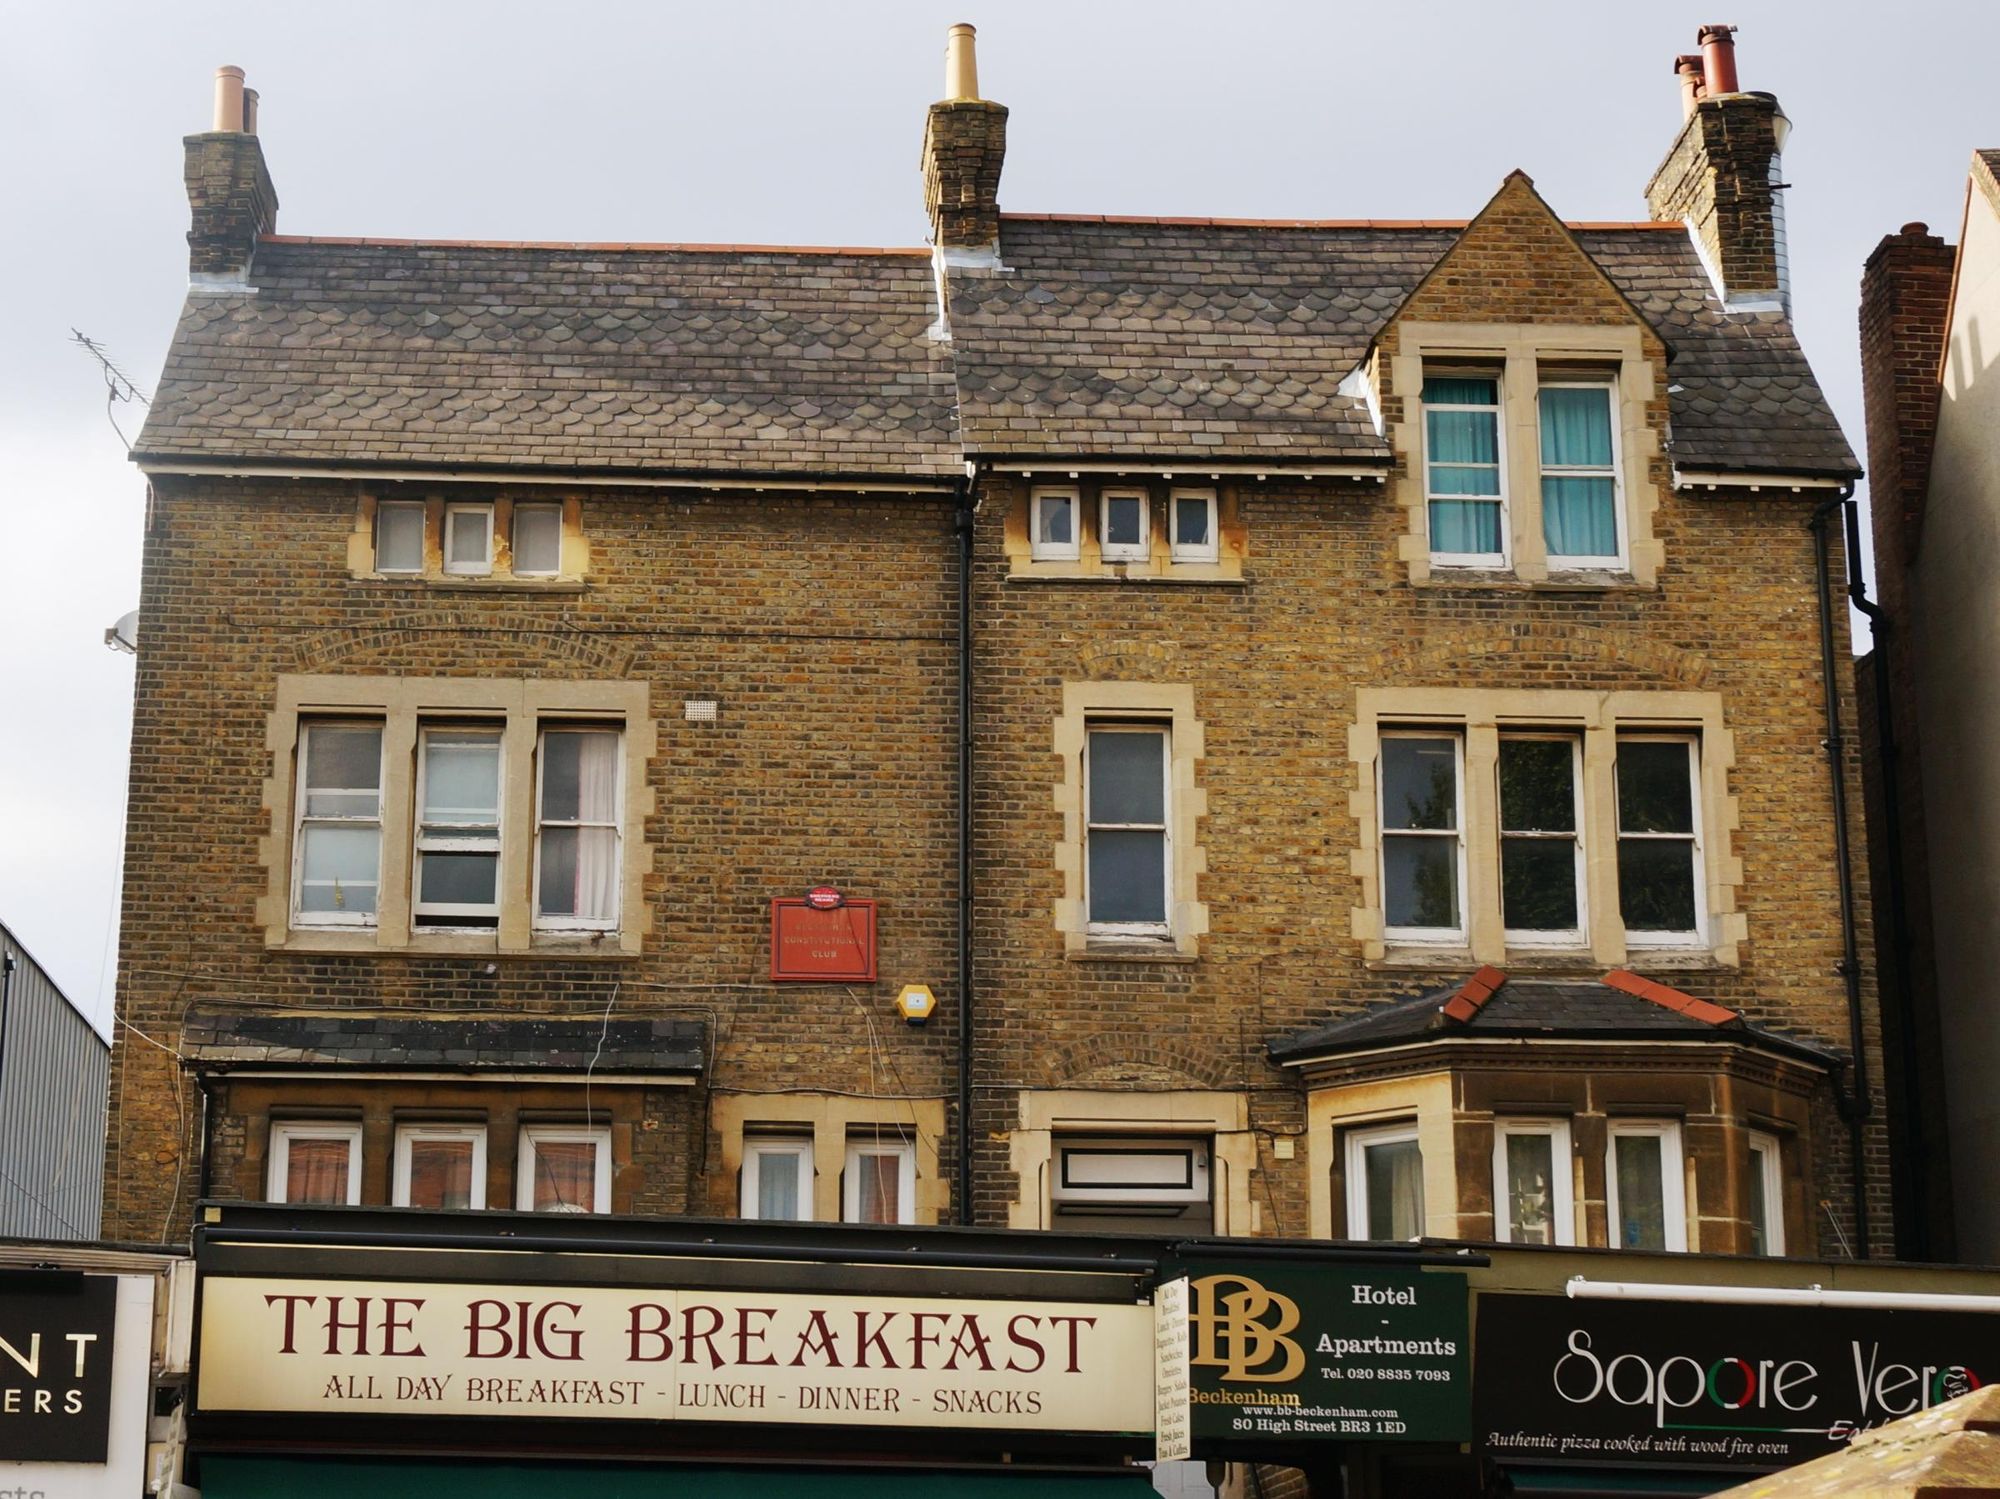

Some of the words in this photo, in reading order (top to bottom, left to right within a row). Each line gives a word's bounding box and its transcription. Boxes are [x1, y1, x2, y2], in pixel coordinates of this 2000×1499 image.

[811, 950, 838, 959] CLUB
[1352, 1285, 1417, 1306] Hotel
[263, 1294, 427, 1358] THE
[463, 1299, 585, 1361] BIG
[624, 1303, 1098, 1375] BREAKFAST
[1315, 1333, 1457, 1359] Apartments
[1321, 1367, 1345, 1379] Tel.
[1347, 1367, 1374, 1380] 020
[1416, 1369, 1451, 1382] 7093
[1553, 1329, 1818, 1429] Sapore
[4, 1388, 83, 1414] ERS
[323, 1374, 383, 1400] ALL
[396, 1374, 453, 1401] DAY
[466, 1377, 645, 1405] BREAKFAST
[679, 1383, 765, 1409] LUNCH
[798, 1386, 900, 1414] DINNER
[932, 1389, 1042, 1415] SNACKS
[1189, 1387, 1301, 1406] Beckenham
[1242, 1405, 1399, 1419] www.bb-beckenham.com
[1232, 1417, 1253, 1431] 80
[1256, 1418, 1292, 1434] High
[1295, 1419, 1337, 1433] Street
[1340, 1420, 1371, 1433] BR3
[1376, 1421, 1407, 1434] 1ED
[1485, 1431, 1558, 1448] Authentic
[1560, 1434, 1601, 1453] pizza
[1603, 1434, 1652, 1453] cooked
[1654, 1435, 1686, 1452] with
[1690, 1438, 1727, 1454] wood
[1727, 1438, 1754, 1458] fire
[1757, 1442, 1789, 1455] oven
